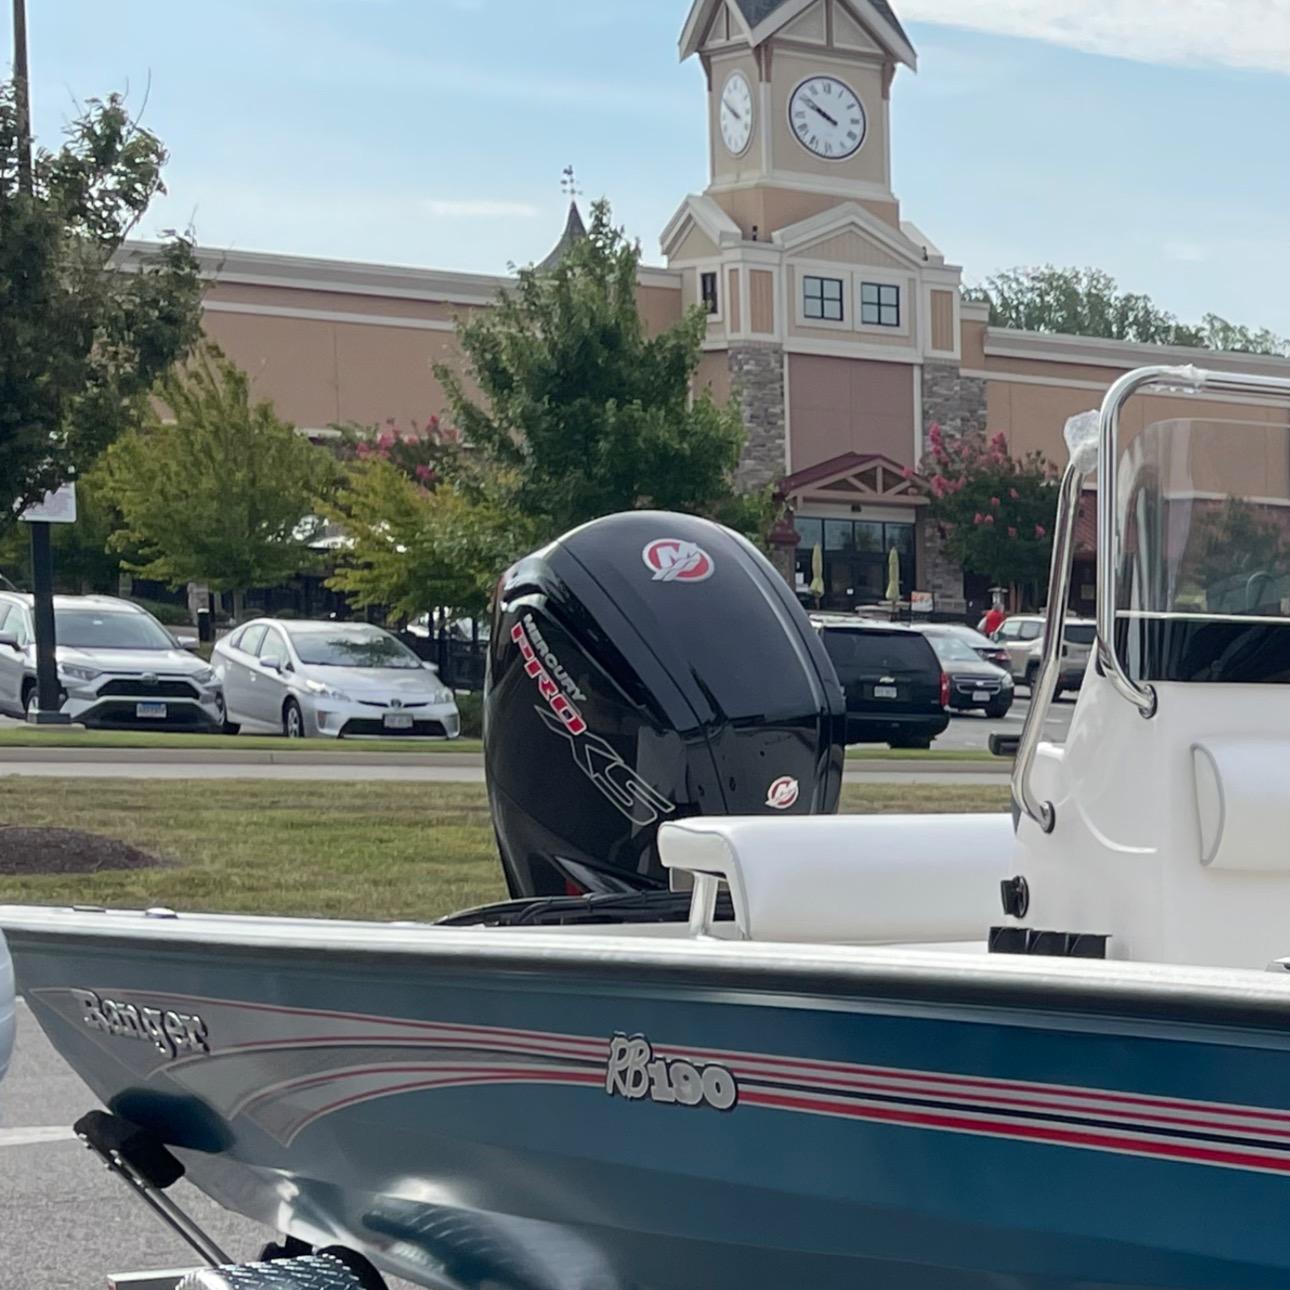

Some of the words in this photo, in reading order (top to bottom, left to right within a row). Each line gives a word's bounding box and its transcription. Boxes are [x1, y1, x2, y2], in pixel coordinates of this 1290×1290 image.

[510, 621, 588, 736] PRO
[523, 613, 587, 701] MERCURY
[80, 988, 210, 1059] Ranger
